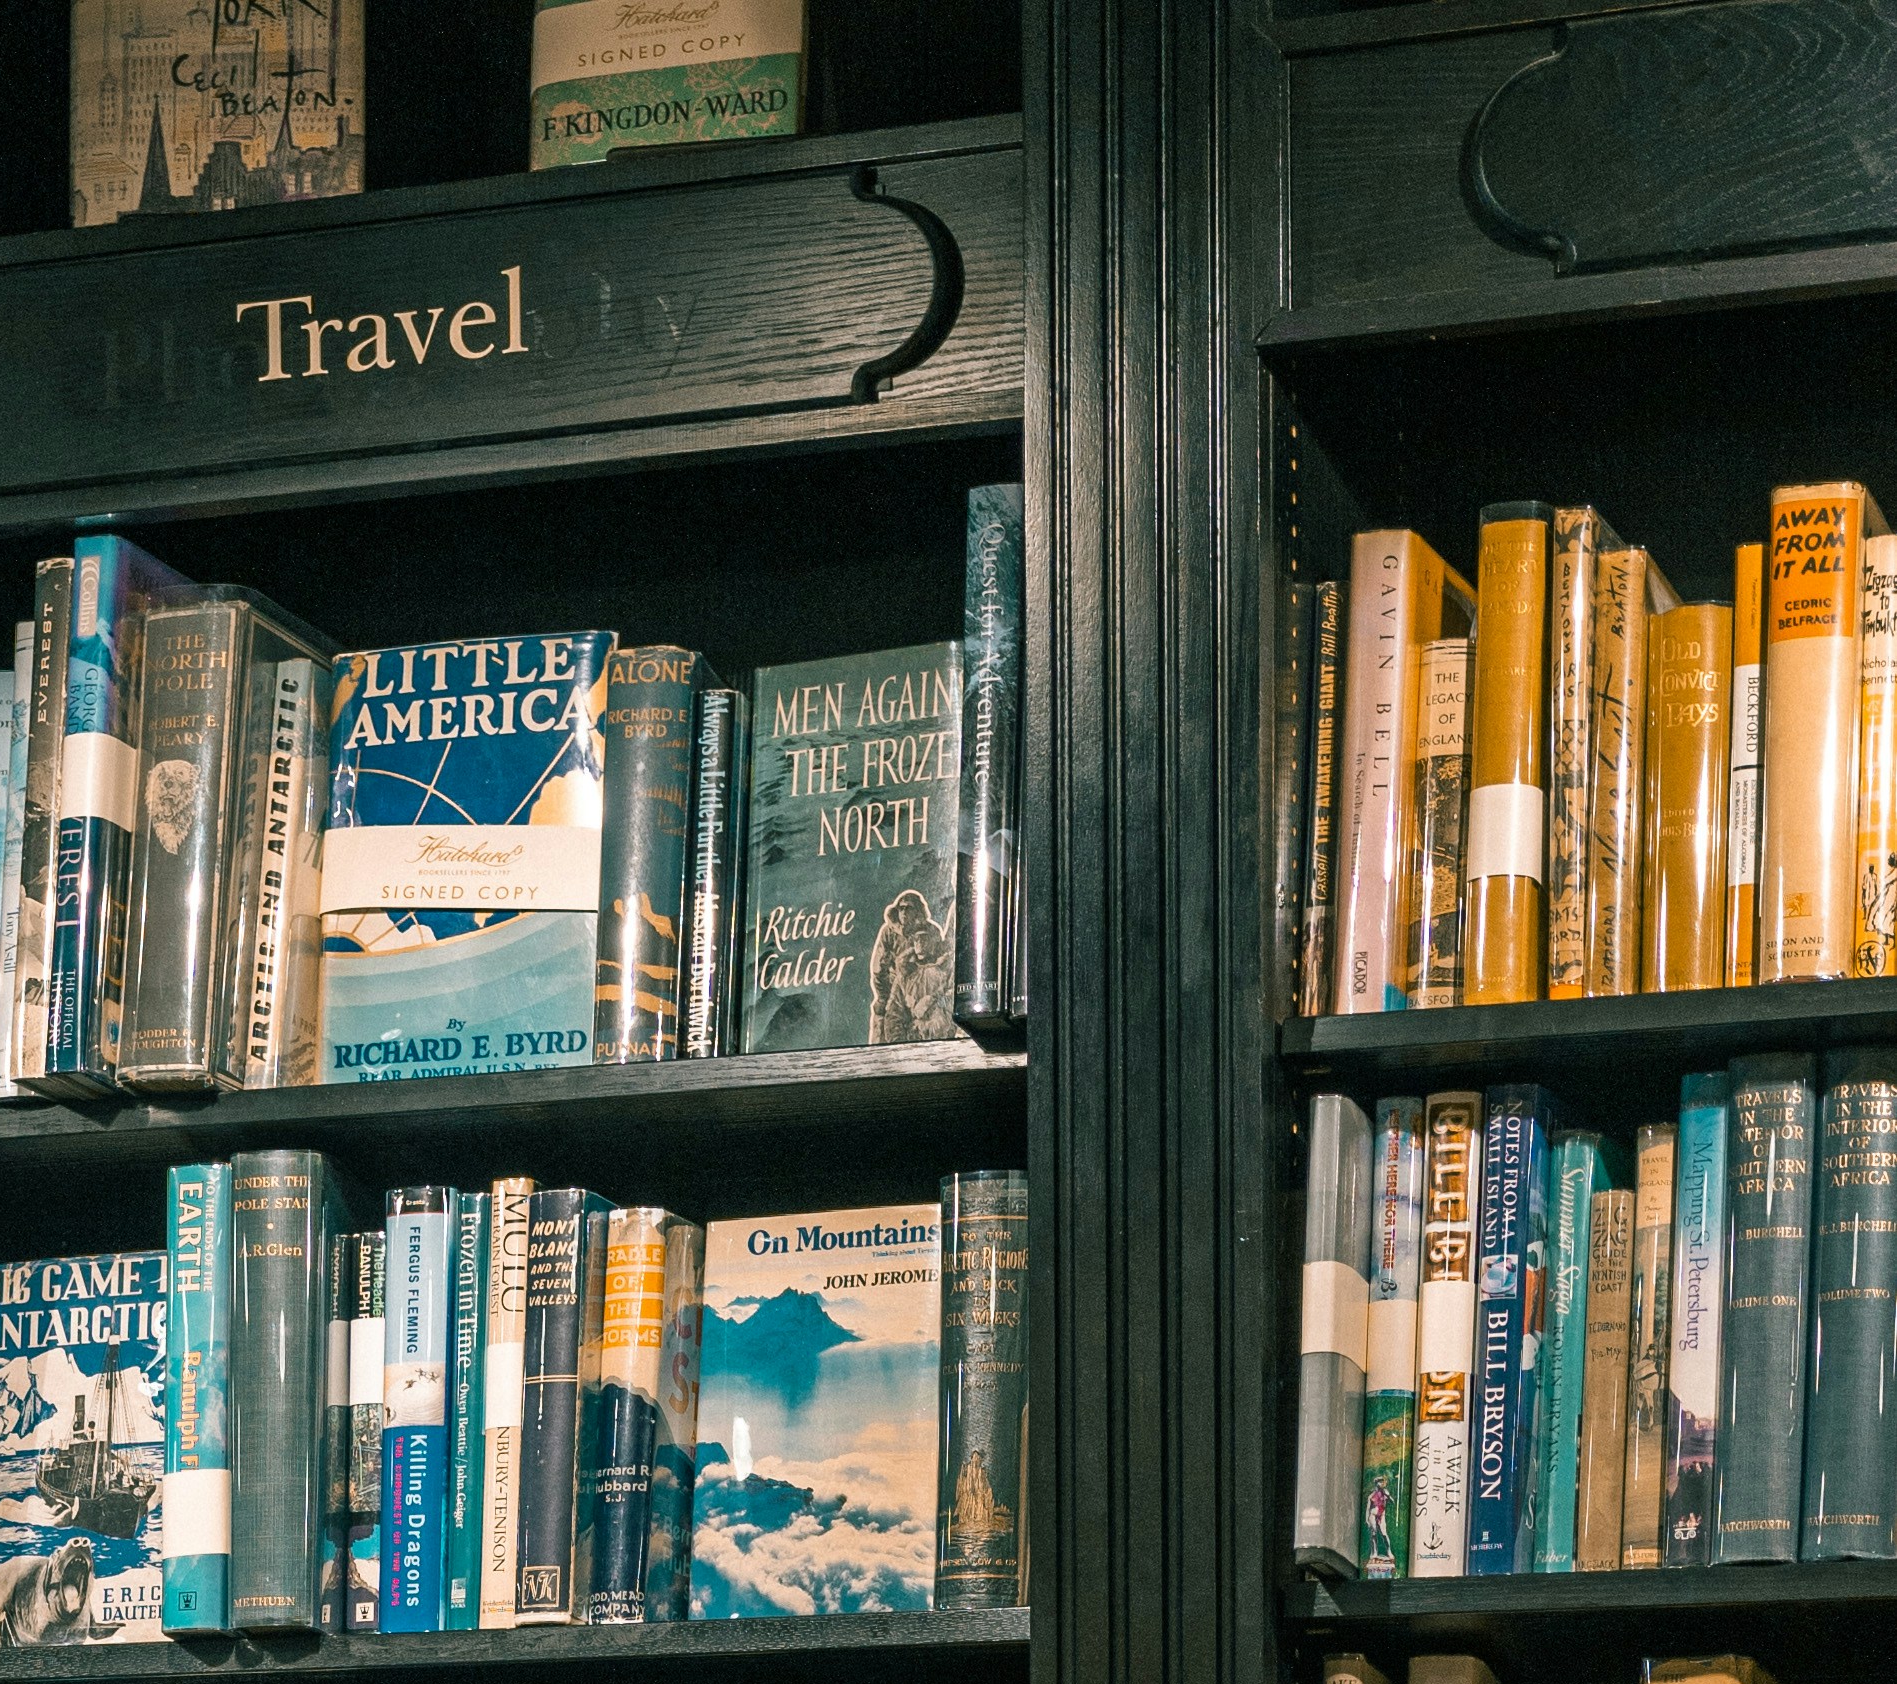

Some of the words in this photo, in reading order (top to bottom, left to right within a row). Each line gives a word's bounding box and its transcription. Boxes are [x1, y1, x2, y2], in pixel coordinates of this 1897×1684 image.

[579, 44, 666, 67] SIGNED
[682, 34, 745, 53] COPY
[237, 266, 529, 382] Travel
[1773, 530, 1846, 557] FROM
[1775, 507, 1846, 529] AWAY
[1773, 560, 1794, 580] IT
[1800, 555, 1846, 575] ALL
[1378, 554, 1398, 671] GAVIN
[1784, 599, 1832, 613] CEDRIC
[363, 638, 578, 699] LITTLE
[610, 660, 691, 687] ALONE
[344, 687, 598, 750] AMERICA
[269, 676, 299, 858] ANTARCTIC
[1373, 703, 1392, 797] BELL
[818, 797, 928, 857] NORTH
[261, 879, 282, 930] AND
[380, 883, 466, 902] SIGNED
[477, 883, 540, 901] COPY
[763, 901, 855, 947] Ritchie
[757, 950, 854, 990] Calder
[251, 939, 278, 1062] ARCTIC
[334, 1036, 462, 1071] RICHARD
[473, 1036, 499, 1061] E.
[507, 1029, 588, 1057] BYRD
[177, 1183, 201, 1293] EARTH
[408, 1225, 421, 1281] FERGUS
[748, 1231, 787, 1257] On
[796, 1220, 939, 1251] Mountains
[41, 1258, 145, 1299] GAME
[823, 1275, 864, 1290] JOHN
[870, 1269, 938, 1287] JEROME
[1679, 1257, 1709, 1351] Petersburg
[406, 1286, 420, 1354] FLEMING
[1486, 1310, 1509, 1379] BILL
[408, 1435, 427, 1505] Killing
[1480, 1386, 1501, 1500] BRYSON
[405, 1512, 425, 1608] Dragons
